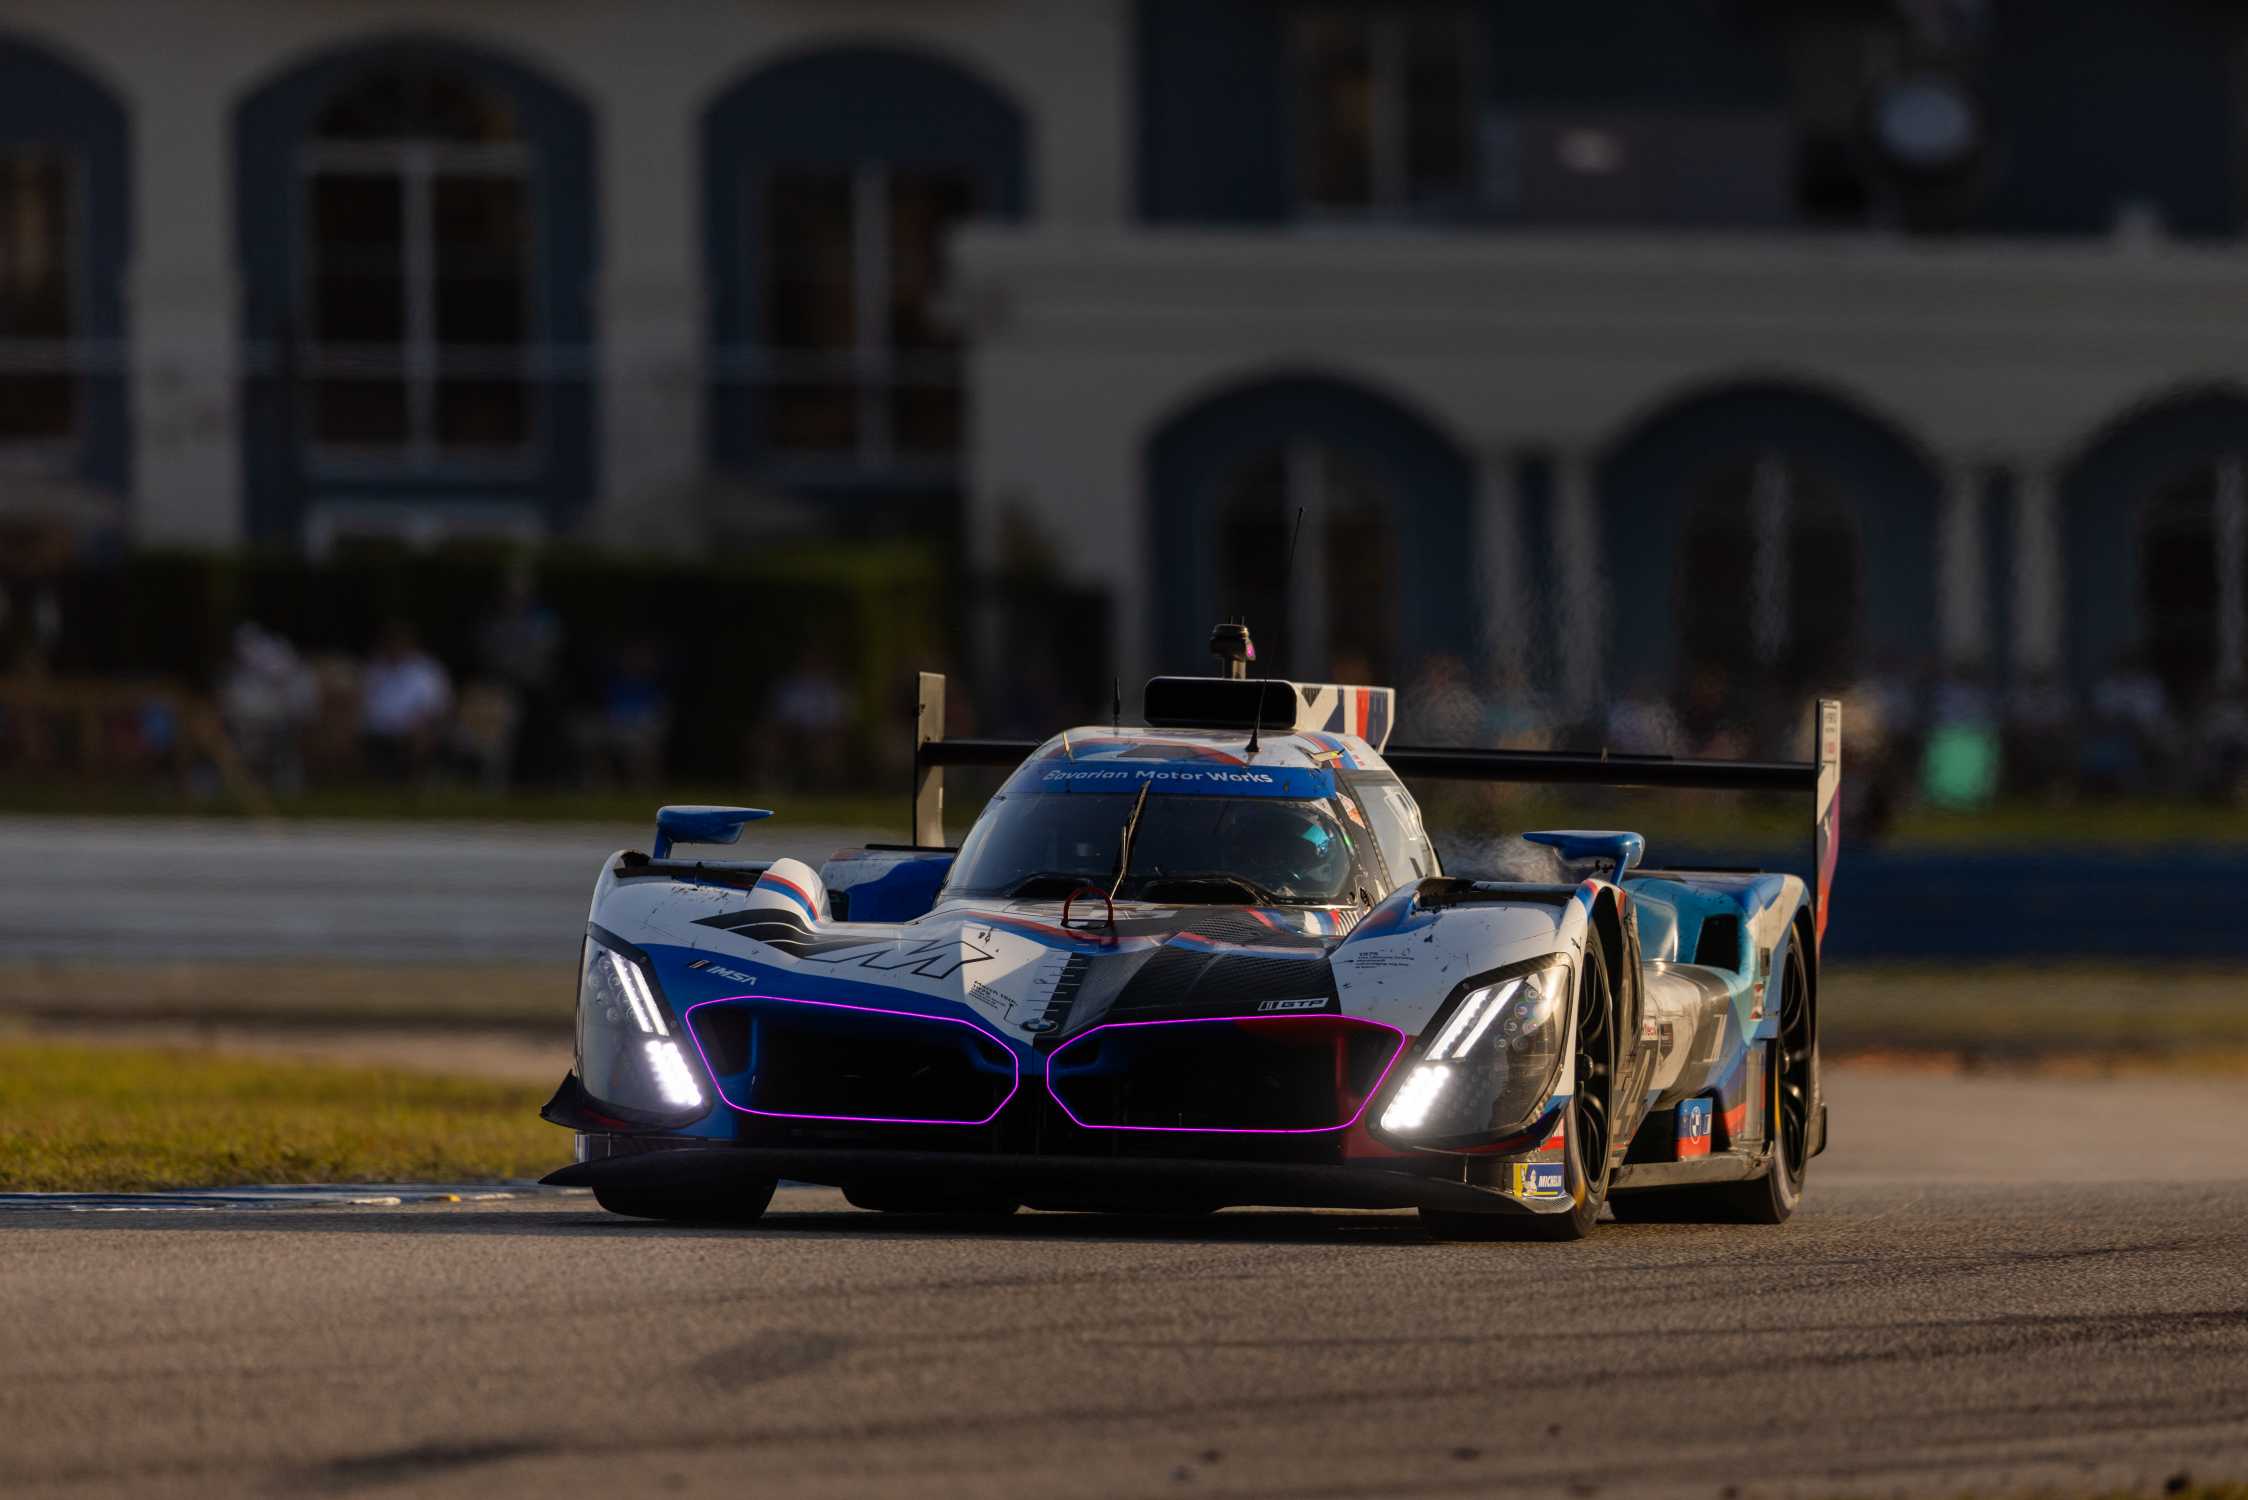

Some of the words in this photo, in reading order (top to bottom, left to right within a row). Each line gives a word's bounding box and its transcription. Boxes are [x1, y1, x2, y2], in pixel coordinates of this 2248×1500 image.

[1043, 769, 1128, 781] Bavarian
[1135, 769, 1203, 781] Motor
[1206, 770, 1273, 783] Works
[706, 965, 757, 986] IMSA
